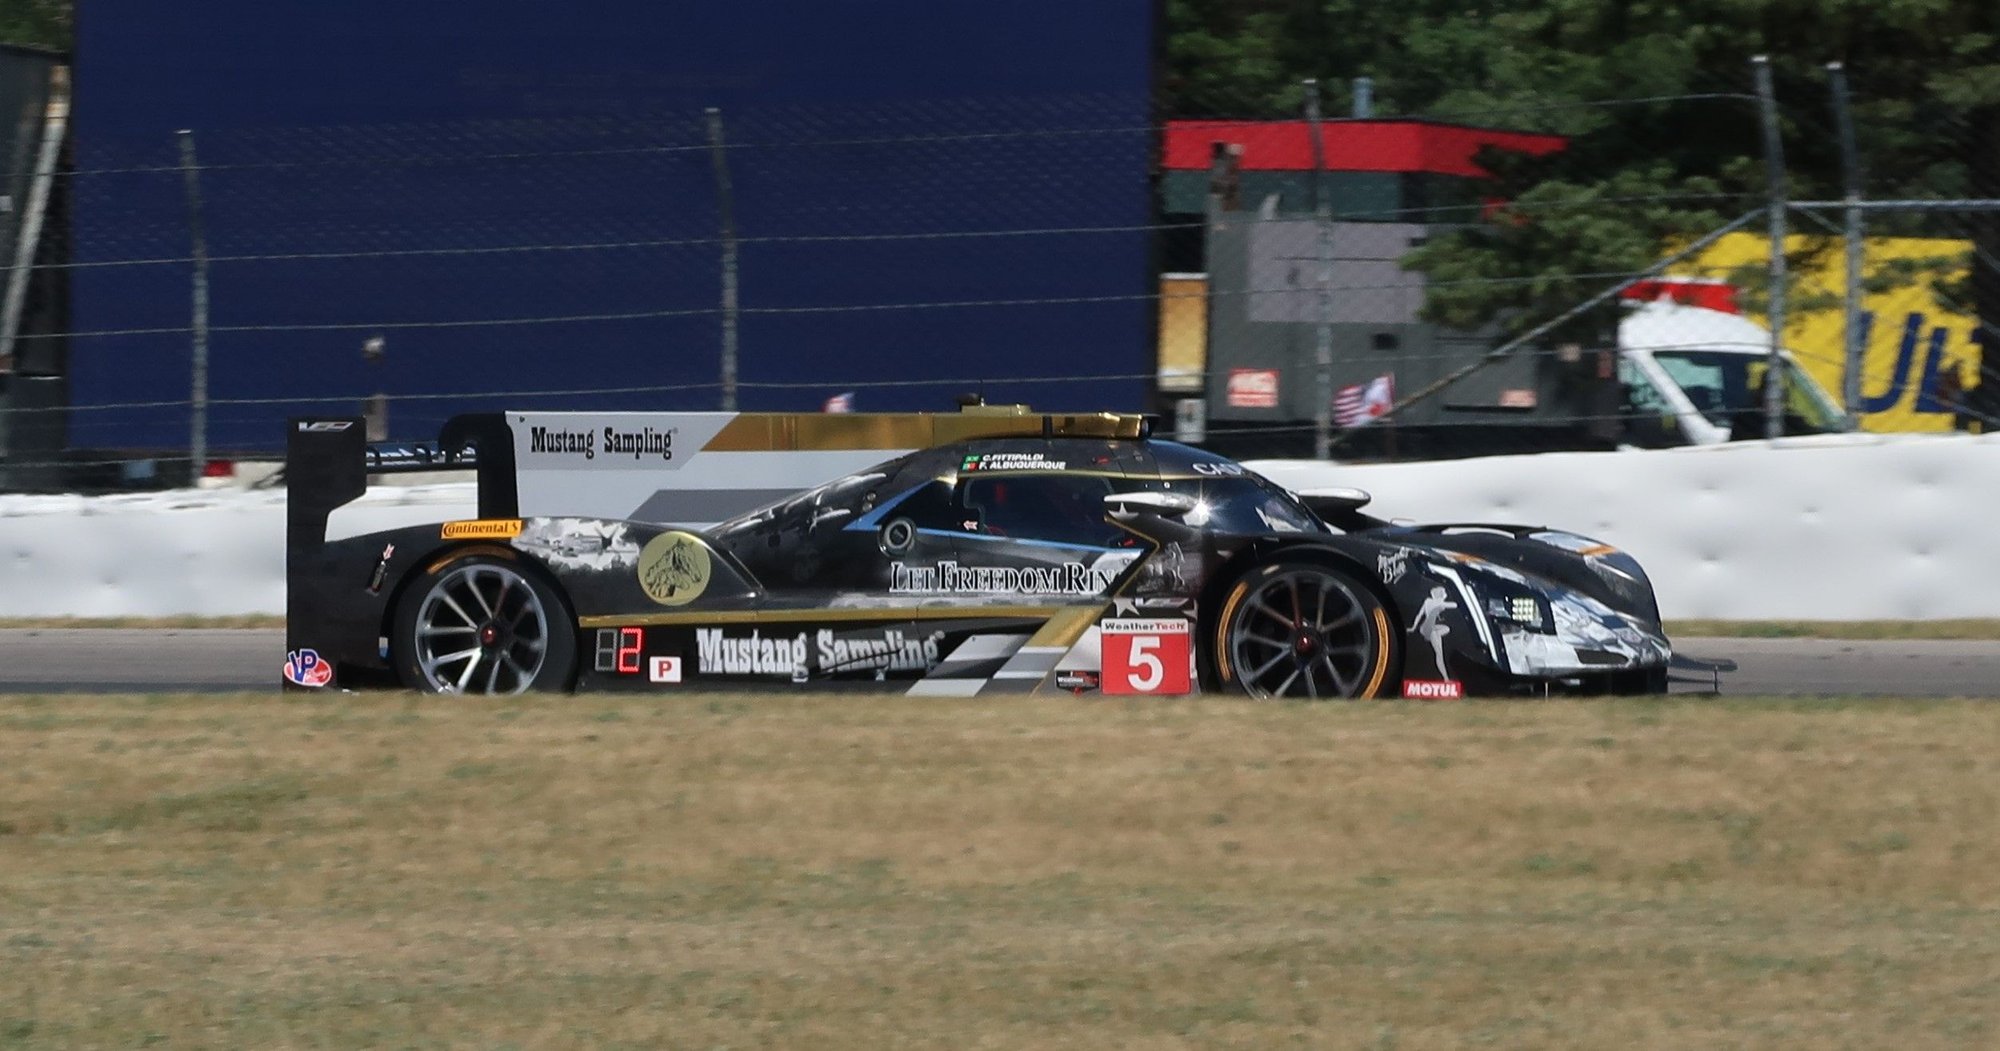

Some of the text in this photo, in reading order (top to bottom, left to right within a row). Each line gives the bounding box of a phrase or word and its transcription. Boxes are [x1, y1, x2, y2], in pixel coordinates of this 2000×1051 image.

[531, 427, 672, 460] Mustang Sampling
[989, 461, 1066, 470] ALBUQUERQUE
[443, 522, 508, 537] Continental
[889, 561, 935, 593] LET
[937, 560, 1061, 593] FREEDOM
[1105, 622, 1184, 631] WeatherTech
[288, 649, 318, 682] VP
[696, 628, 939, 682] Mustang Sampling
[1127, 636, 1164, 692] 5
[658, 660, 672, 678] P
[1407, 682, 1458, 697] MOTUL
